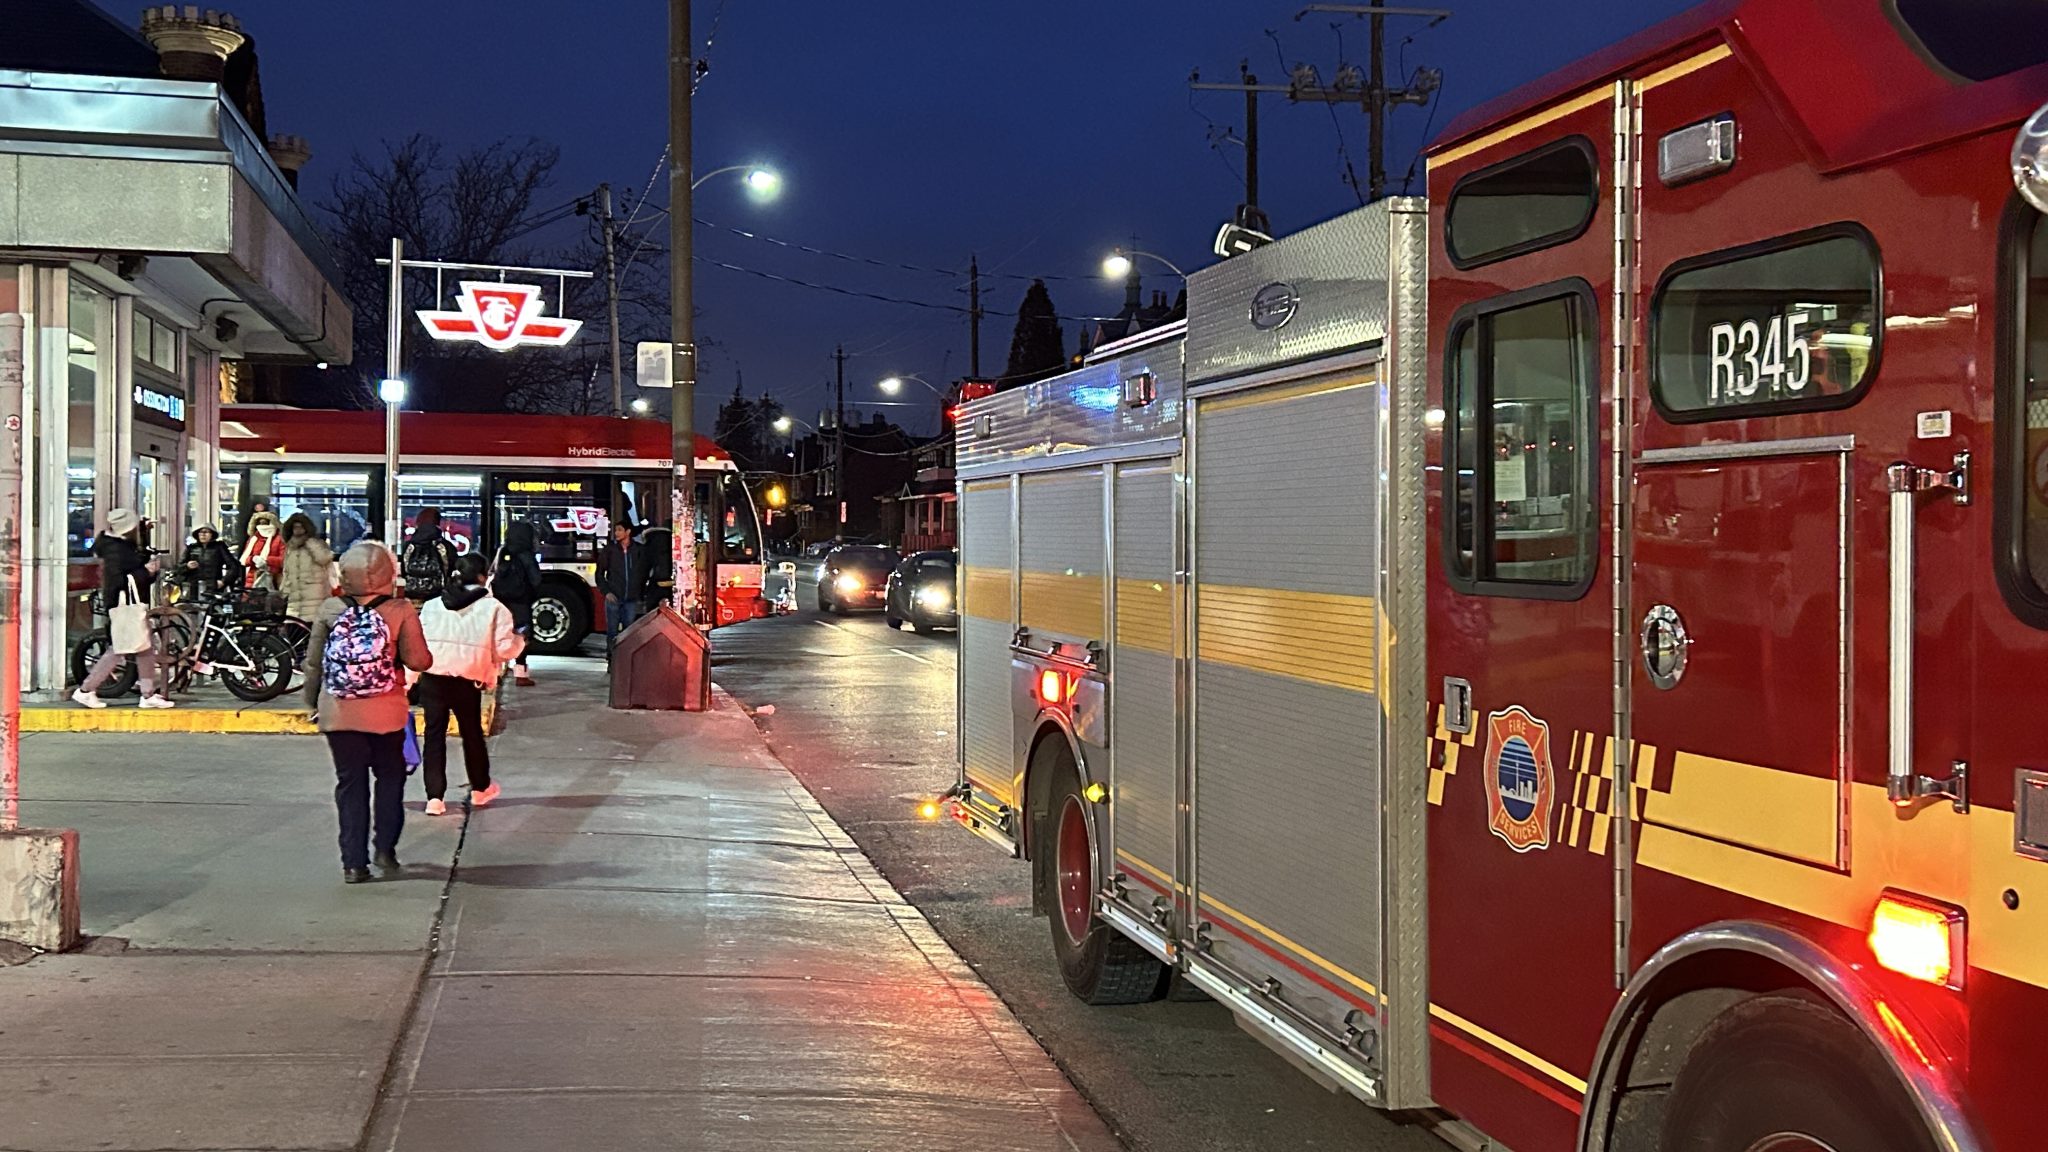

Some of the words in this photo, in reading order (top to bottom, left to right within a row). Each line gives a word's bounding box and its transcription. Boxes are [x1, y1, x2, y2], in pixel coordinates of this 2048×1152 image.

[1711, 313, 1810, 399] R345
[1508, 719, 1527, 736] FIRE
[1499, 812, 1538, 841] SERVICES
